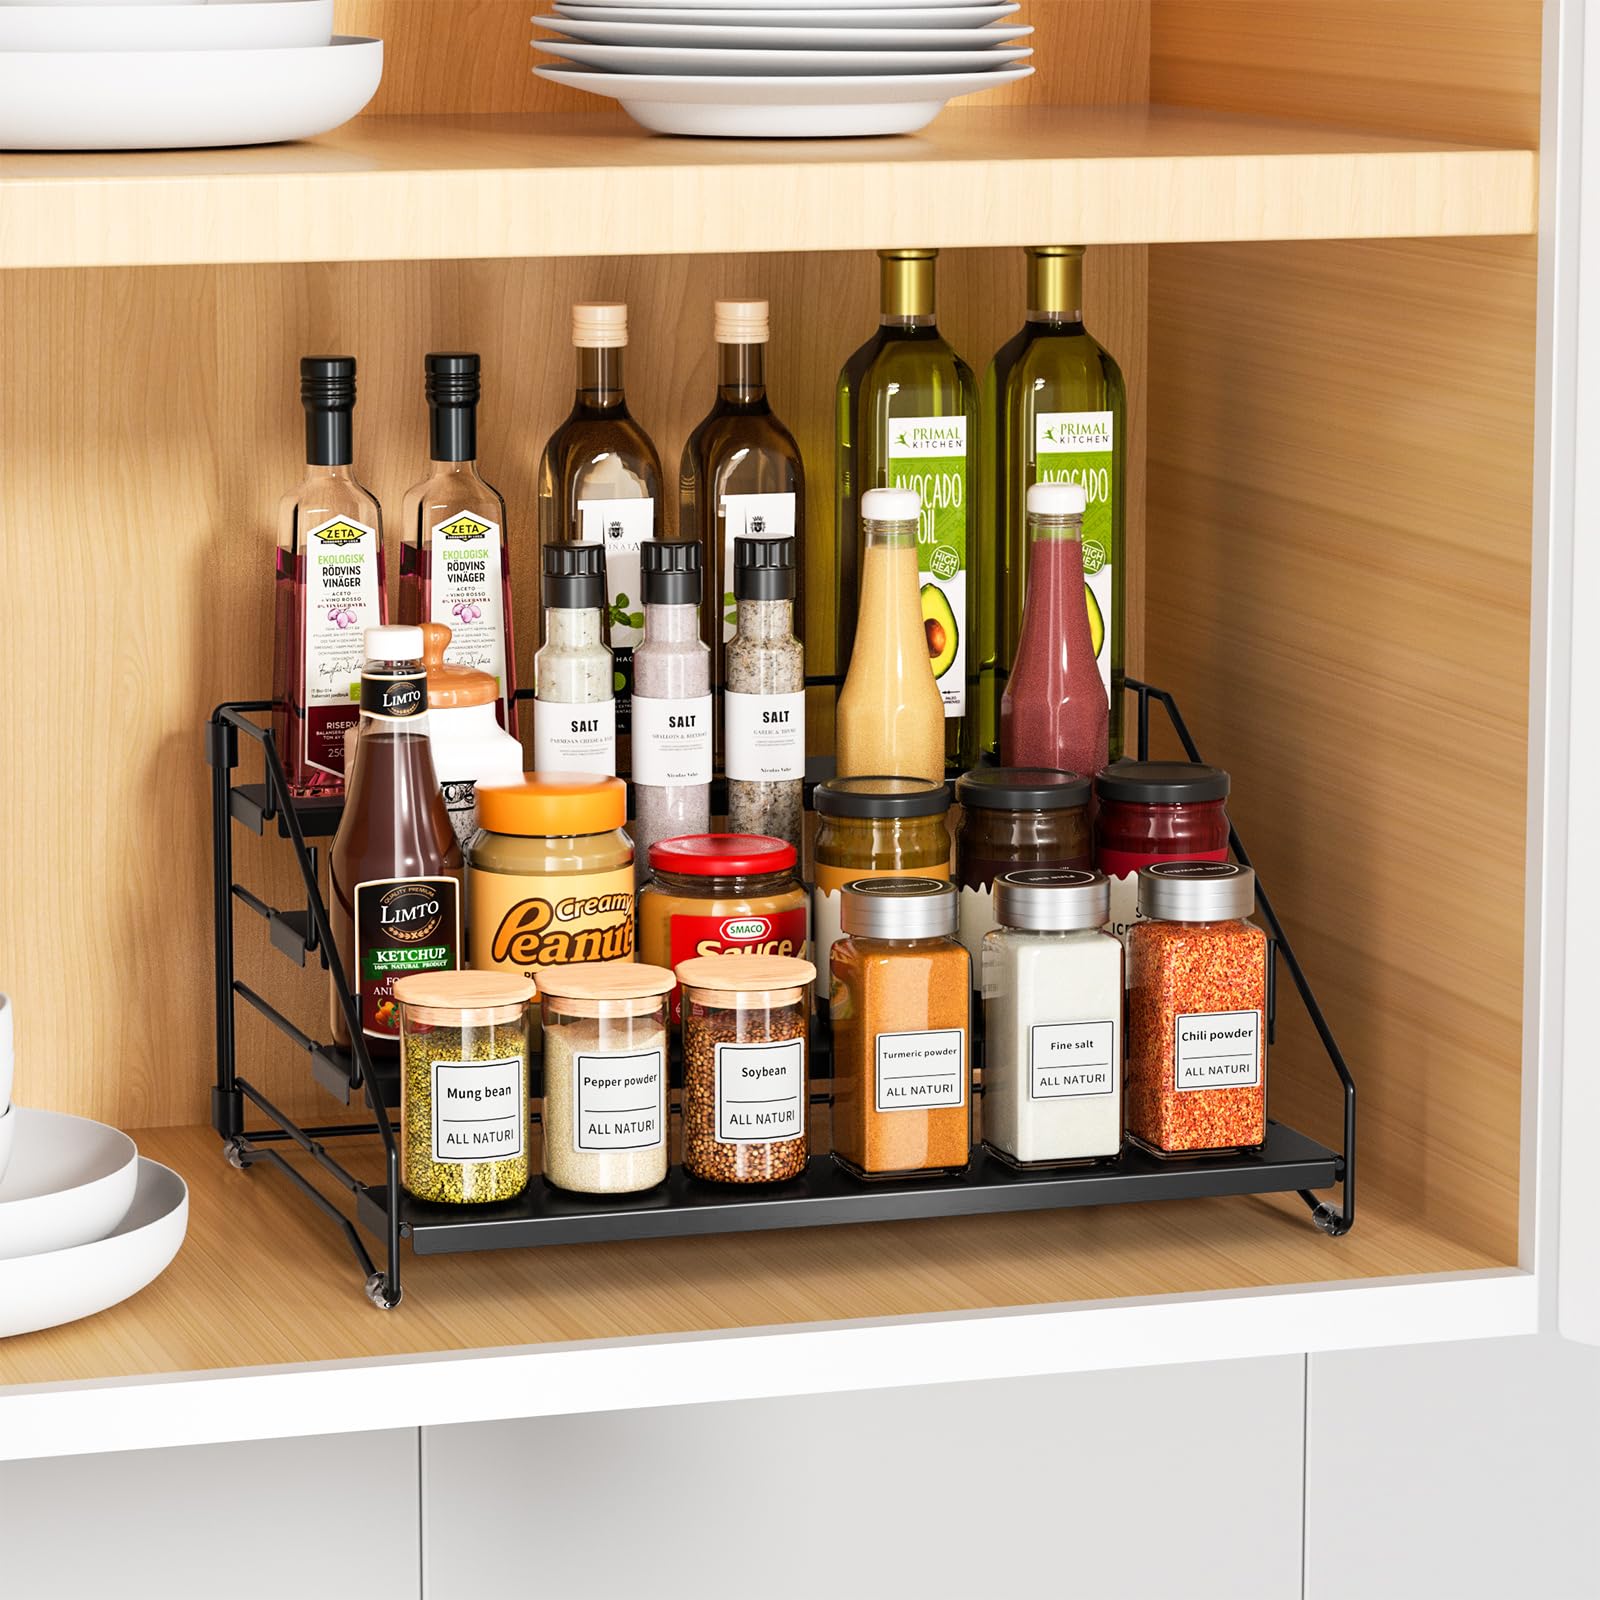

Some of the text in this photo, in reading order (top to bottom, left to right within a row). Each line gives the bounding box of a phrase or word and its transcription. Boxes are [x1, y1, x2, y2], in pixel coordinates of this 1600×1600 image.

[913, 427, 960, 440] PRIMAL
[1060, 422, 1107, 435] PRIMAL
[912, 440, 962, 449] KITCHEN
[1060, 435, 1108, 444] KITCHEN
[452, 524, 479, 533] ZETA
[918, 508, 938, 544] OIL
[327, 529, 355, 538] ZETA
[318, 554, 365, 565] EKOLOGISK
[443, 550, 488, 560] EKOLOGISK
[935, 550, 957, 567] HIGH
[322, 564, 361, 576] RÖDVINS
[447, 560, 485, 571] RÖDVINS
[932, 560, 956, 575] HEAT
[322, 576, 361, 587] VINÄGER
[447, 571, 485, 583] VINÄGER
[669, 715, 696, 728] SALT
[763, 710, 790, 723] SALT
[327, 721, 357, 729] RISERV
[571, 720, 598, 732] SALT
[384, 888, 434, 904] QUALITY PREMIUM
[555, 893, 632, 921] Creamy
[492, 897, 632, 966] Peanut
[730, 925, 763, 934] SMACO
[376, 948, 446, 962] KETCHUP
[1182, 1028, 1254, 1042] Chili powder
[1050, 1039, 1094, 1050] Fine salt
[883, 1047, 957, 1059] Turmeric powder
[741, 1066, 787, 1080] Soybean
[1185, 1064, 1250, 1077] ALL NATURI
[584, 1073, 657, 1089] Pepper powder
[1040, 1073, 1106, 1086] ALL NATURI
[447, 1085, 511, 1101] Mung bean
[886, 1084, 953, 1097] ALL NATURI
[730, 1110, 795, 1125] ALL NATURI
[588, 1120, 654, 1135] ALL NATURI
[446, 1129, 514, 1144] ALL NATURI
